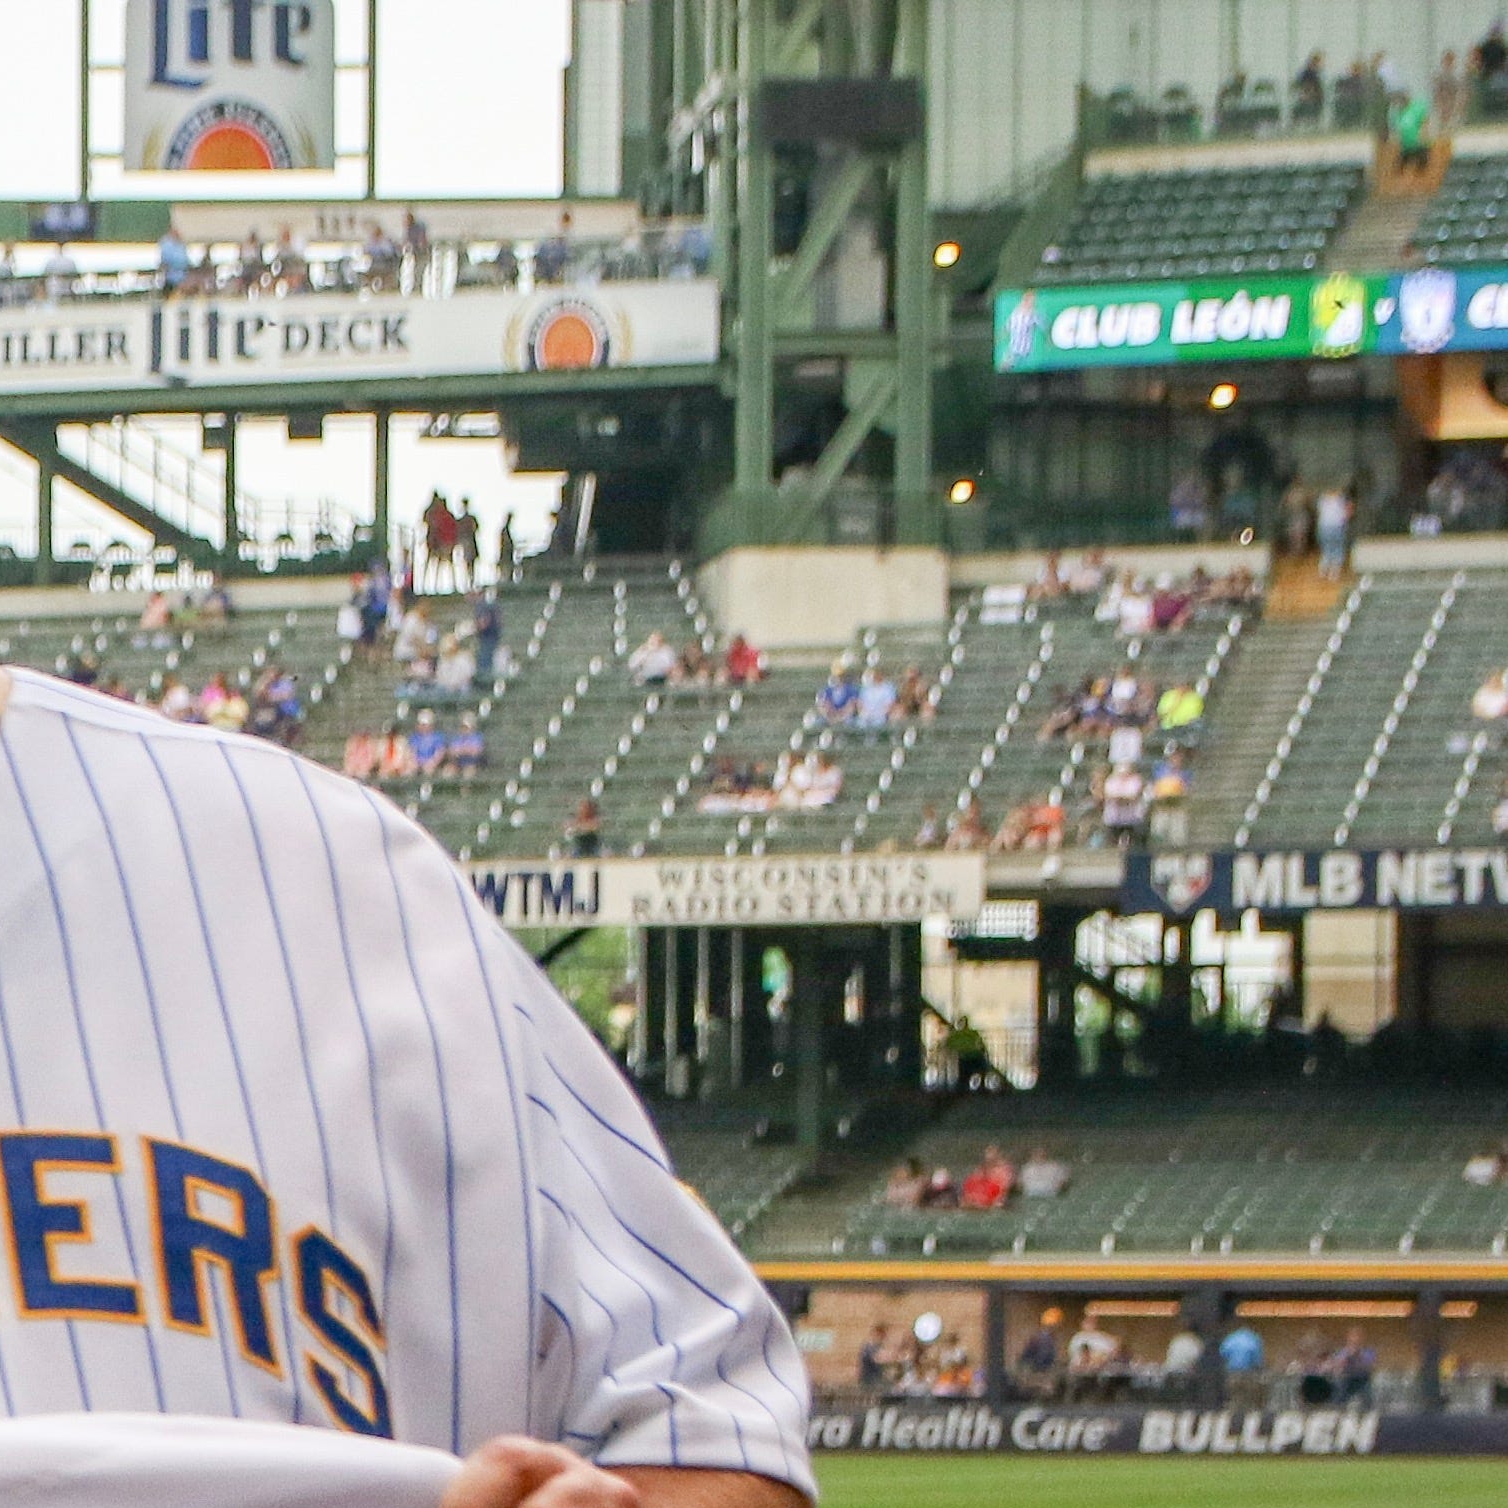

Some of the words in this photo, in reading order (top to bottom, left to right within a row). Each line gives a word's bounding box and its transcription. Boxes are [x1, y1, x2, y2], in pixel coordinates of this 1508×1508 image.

[282, 314, 411, 354] DECK
[1050, 300, 1162, 350] CLUB
[1169, 288, 1291, 345] LEÓN
[473, 869, 601, 917] WTMJ
[656, 862, 930, 892] WISCONSIN'S
[1232, 851, 1364, 909] MLB
[631, 892, 761, 922] RADIO
[775, 889, 957, 919] STATION
[860, 1404, 1003, 1450] Health
[1011, 1405, 1111, 1450] Care
[1137, 1406, 1380, 1454] BULLPEN
